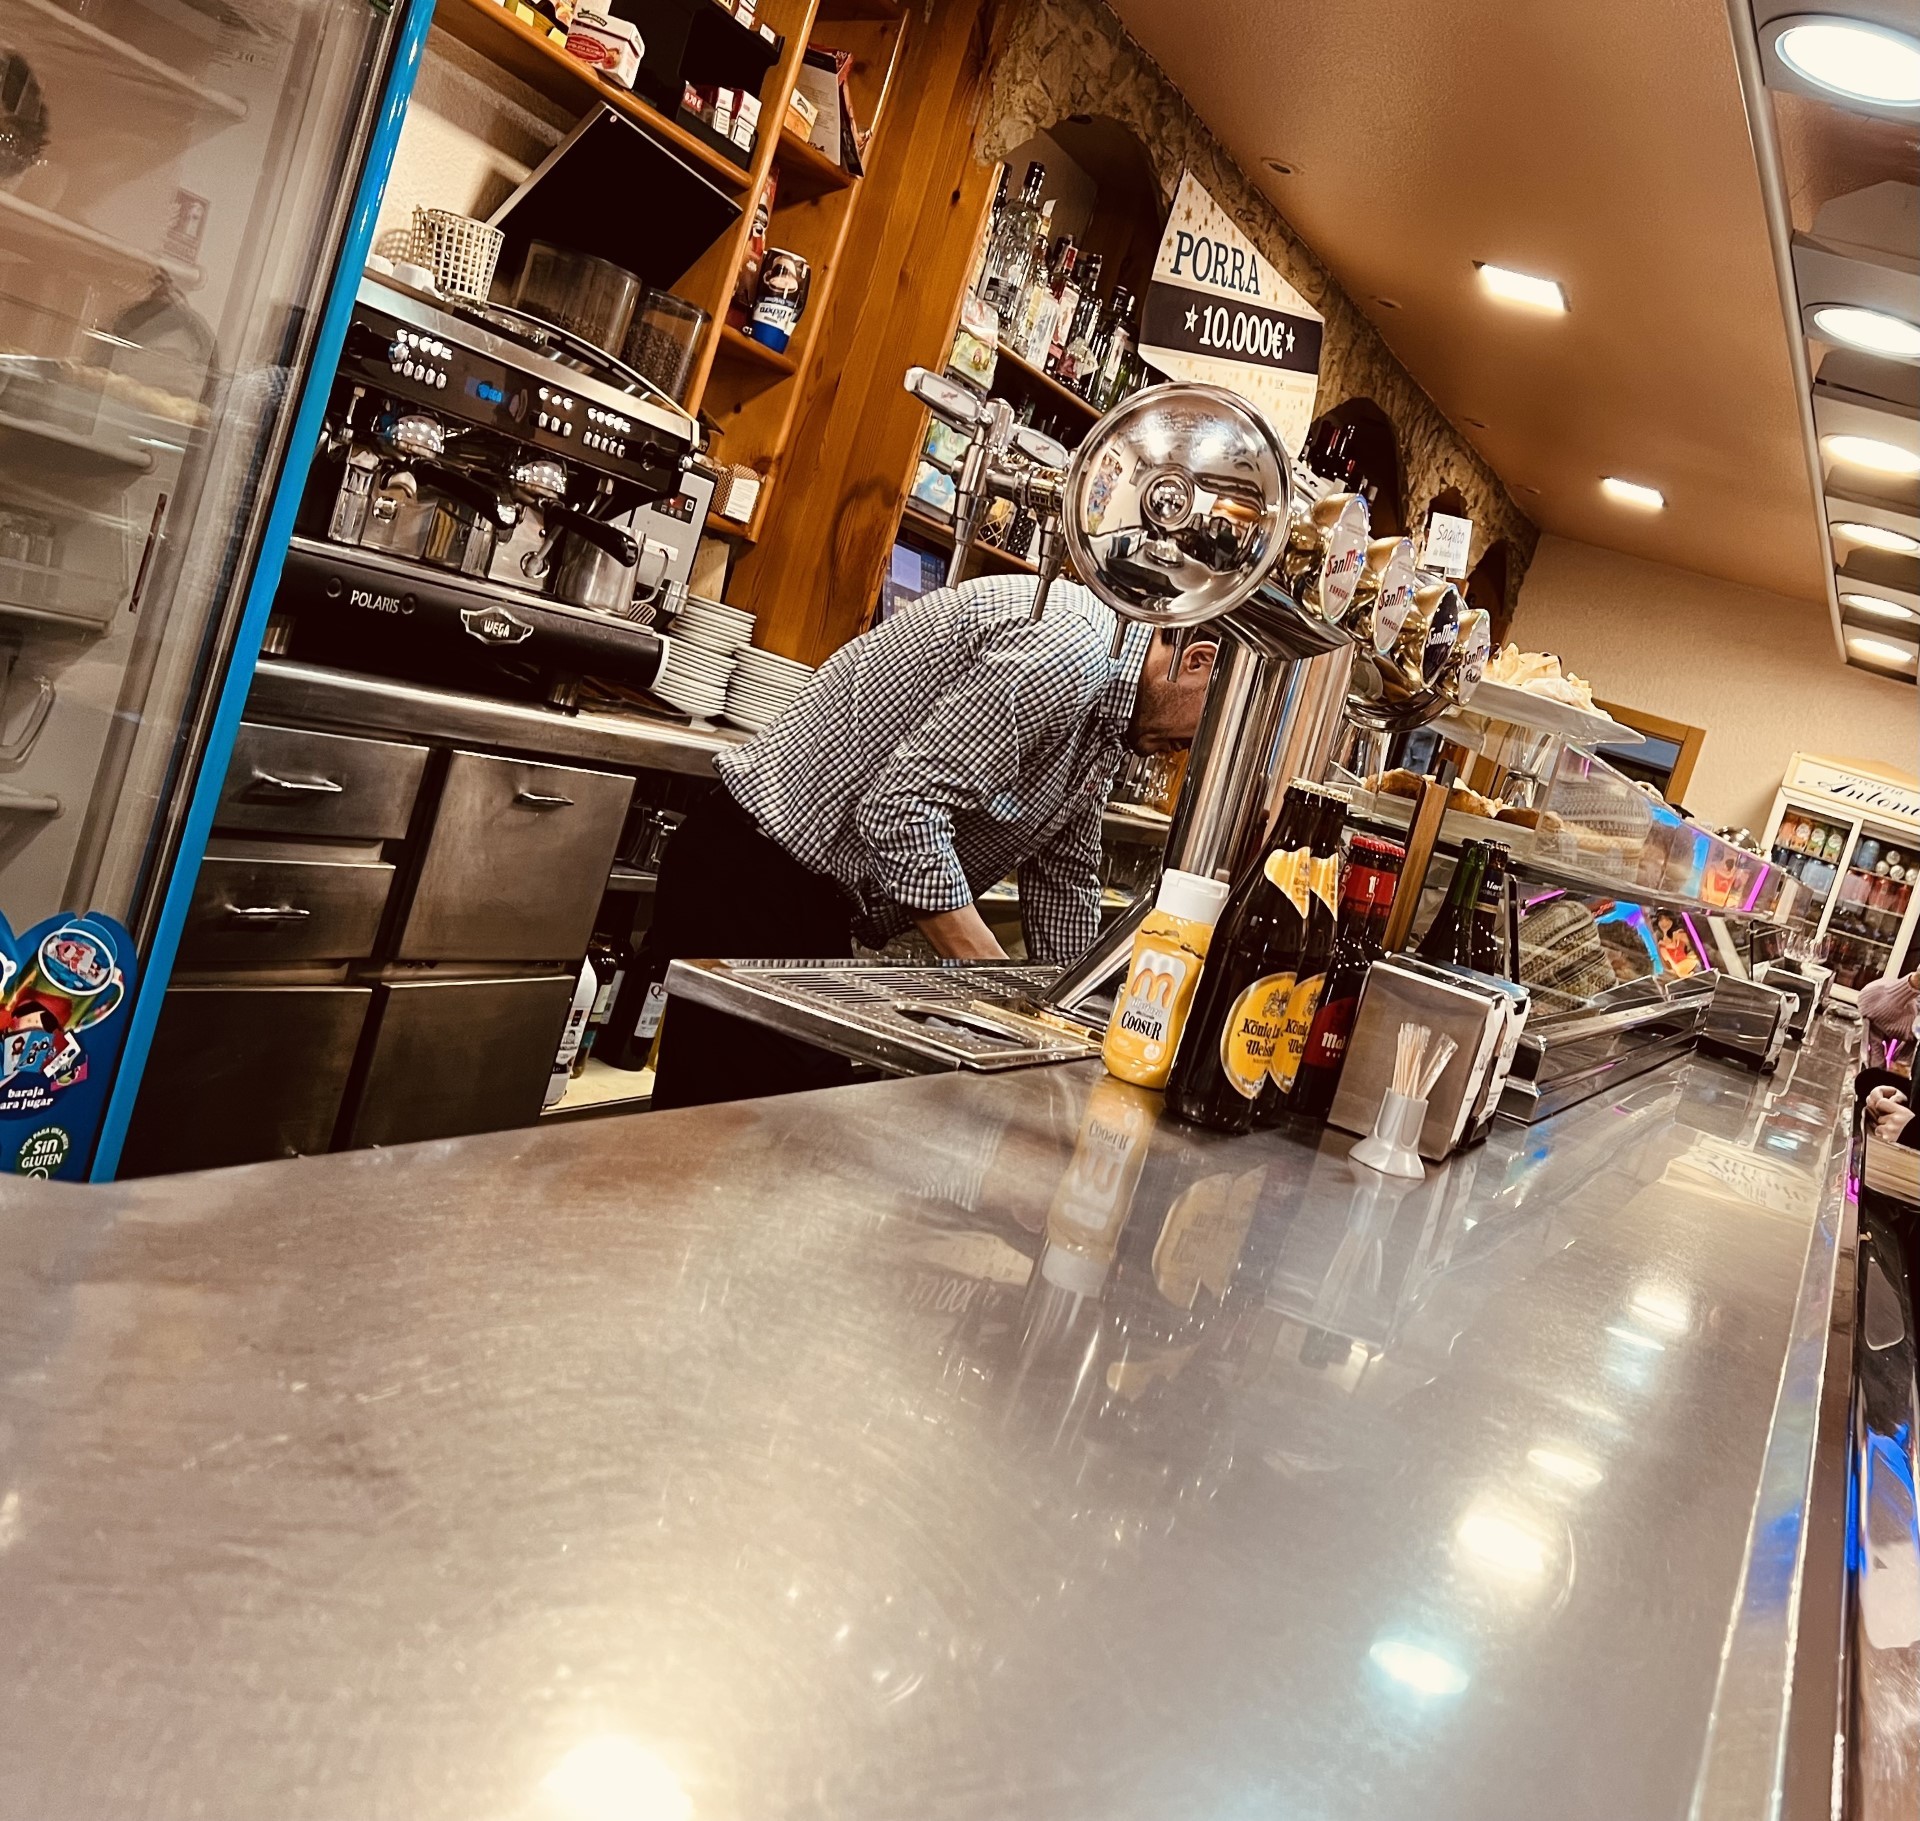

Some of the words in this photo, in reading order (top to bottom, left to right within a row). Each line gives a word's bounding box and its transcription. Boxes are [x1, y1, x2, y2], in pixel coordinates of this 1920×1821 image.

[1170, 230, 1261, 295] PORRA
[1199, 305, 1285, 360] 10.000€
[350, 589, 400, 614] POLARIS
[483, 619, 510, 638] WEGA
[8, 1086, 44, 1098] baraja
[0, 1101, 20, 1110] ara
[21, 1098, 54, 1110] jugar
[21, 1152, 63, 1168] GLUTEN
